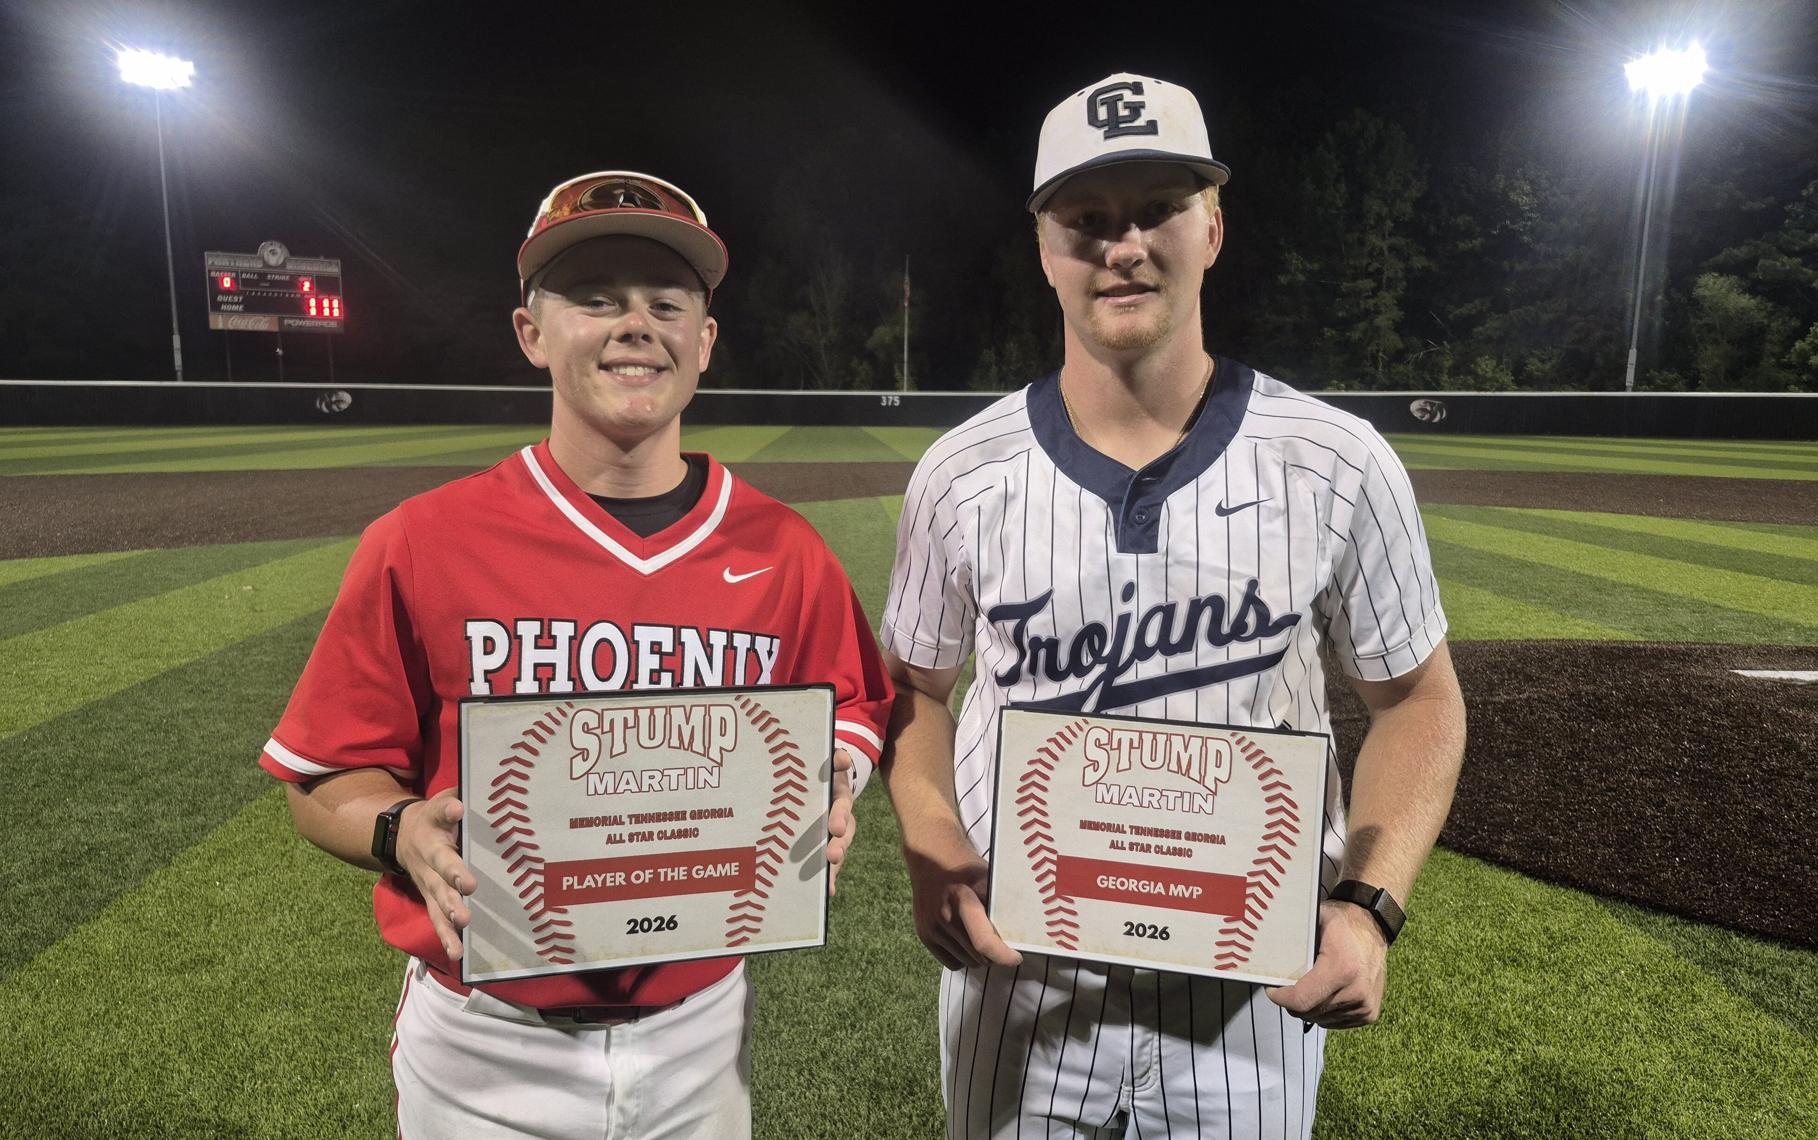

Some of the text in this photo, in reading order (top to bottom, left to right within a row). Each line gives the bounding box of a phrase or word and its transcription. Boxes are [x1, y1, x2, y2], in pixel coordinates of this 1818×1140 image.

[241, 272, 259, 280] BALL
[221, 304, 244, 312] HOME
[881, 395, 900, 406] 375
[987, 577, 1302, 711] Trojans
[465, 618, 781, 696] PHOENIX
[570, 703, 738, 780] STUMP
[1082, 726, 1233, 796] STUMP
[587, 766, 721, 796] MARTIN
[1095, 783, 1215, 815] MARTIN
[569, 807, 734, 829] MEMORIAL TENNESSEE GEORGIA
[606, 827, 700, 845] ALL STAR CLASSIC
[1079, 819, 1226, 846] MEMORIAL TENNESSEE GEORGIA
[1109, 839, 1193, 859] ALL STAR CLASSIC
[562, 862, 740, 891] PLAYER OF THE GAME
[1096, 875, 1203, 899] GEORGIA MVP
[626, 915, 679, 935] 2026
[1123, 921, 1170, 941] 2026
